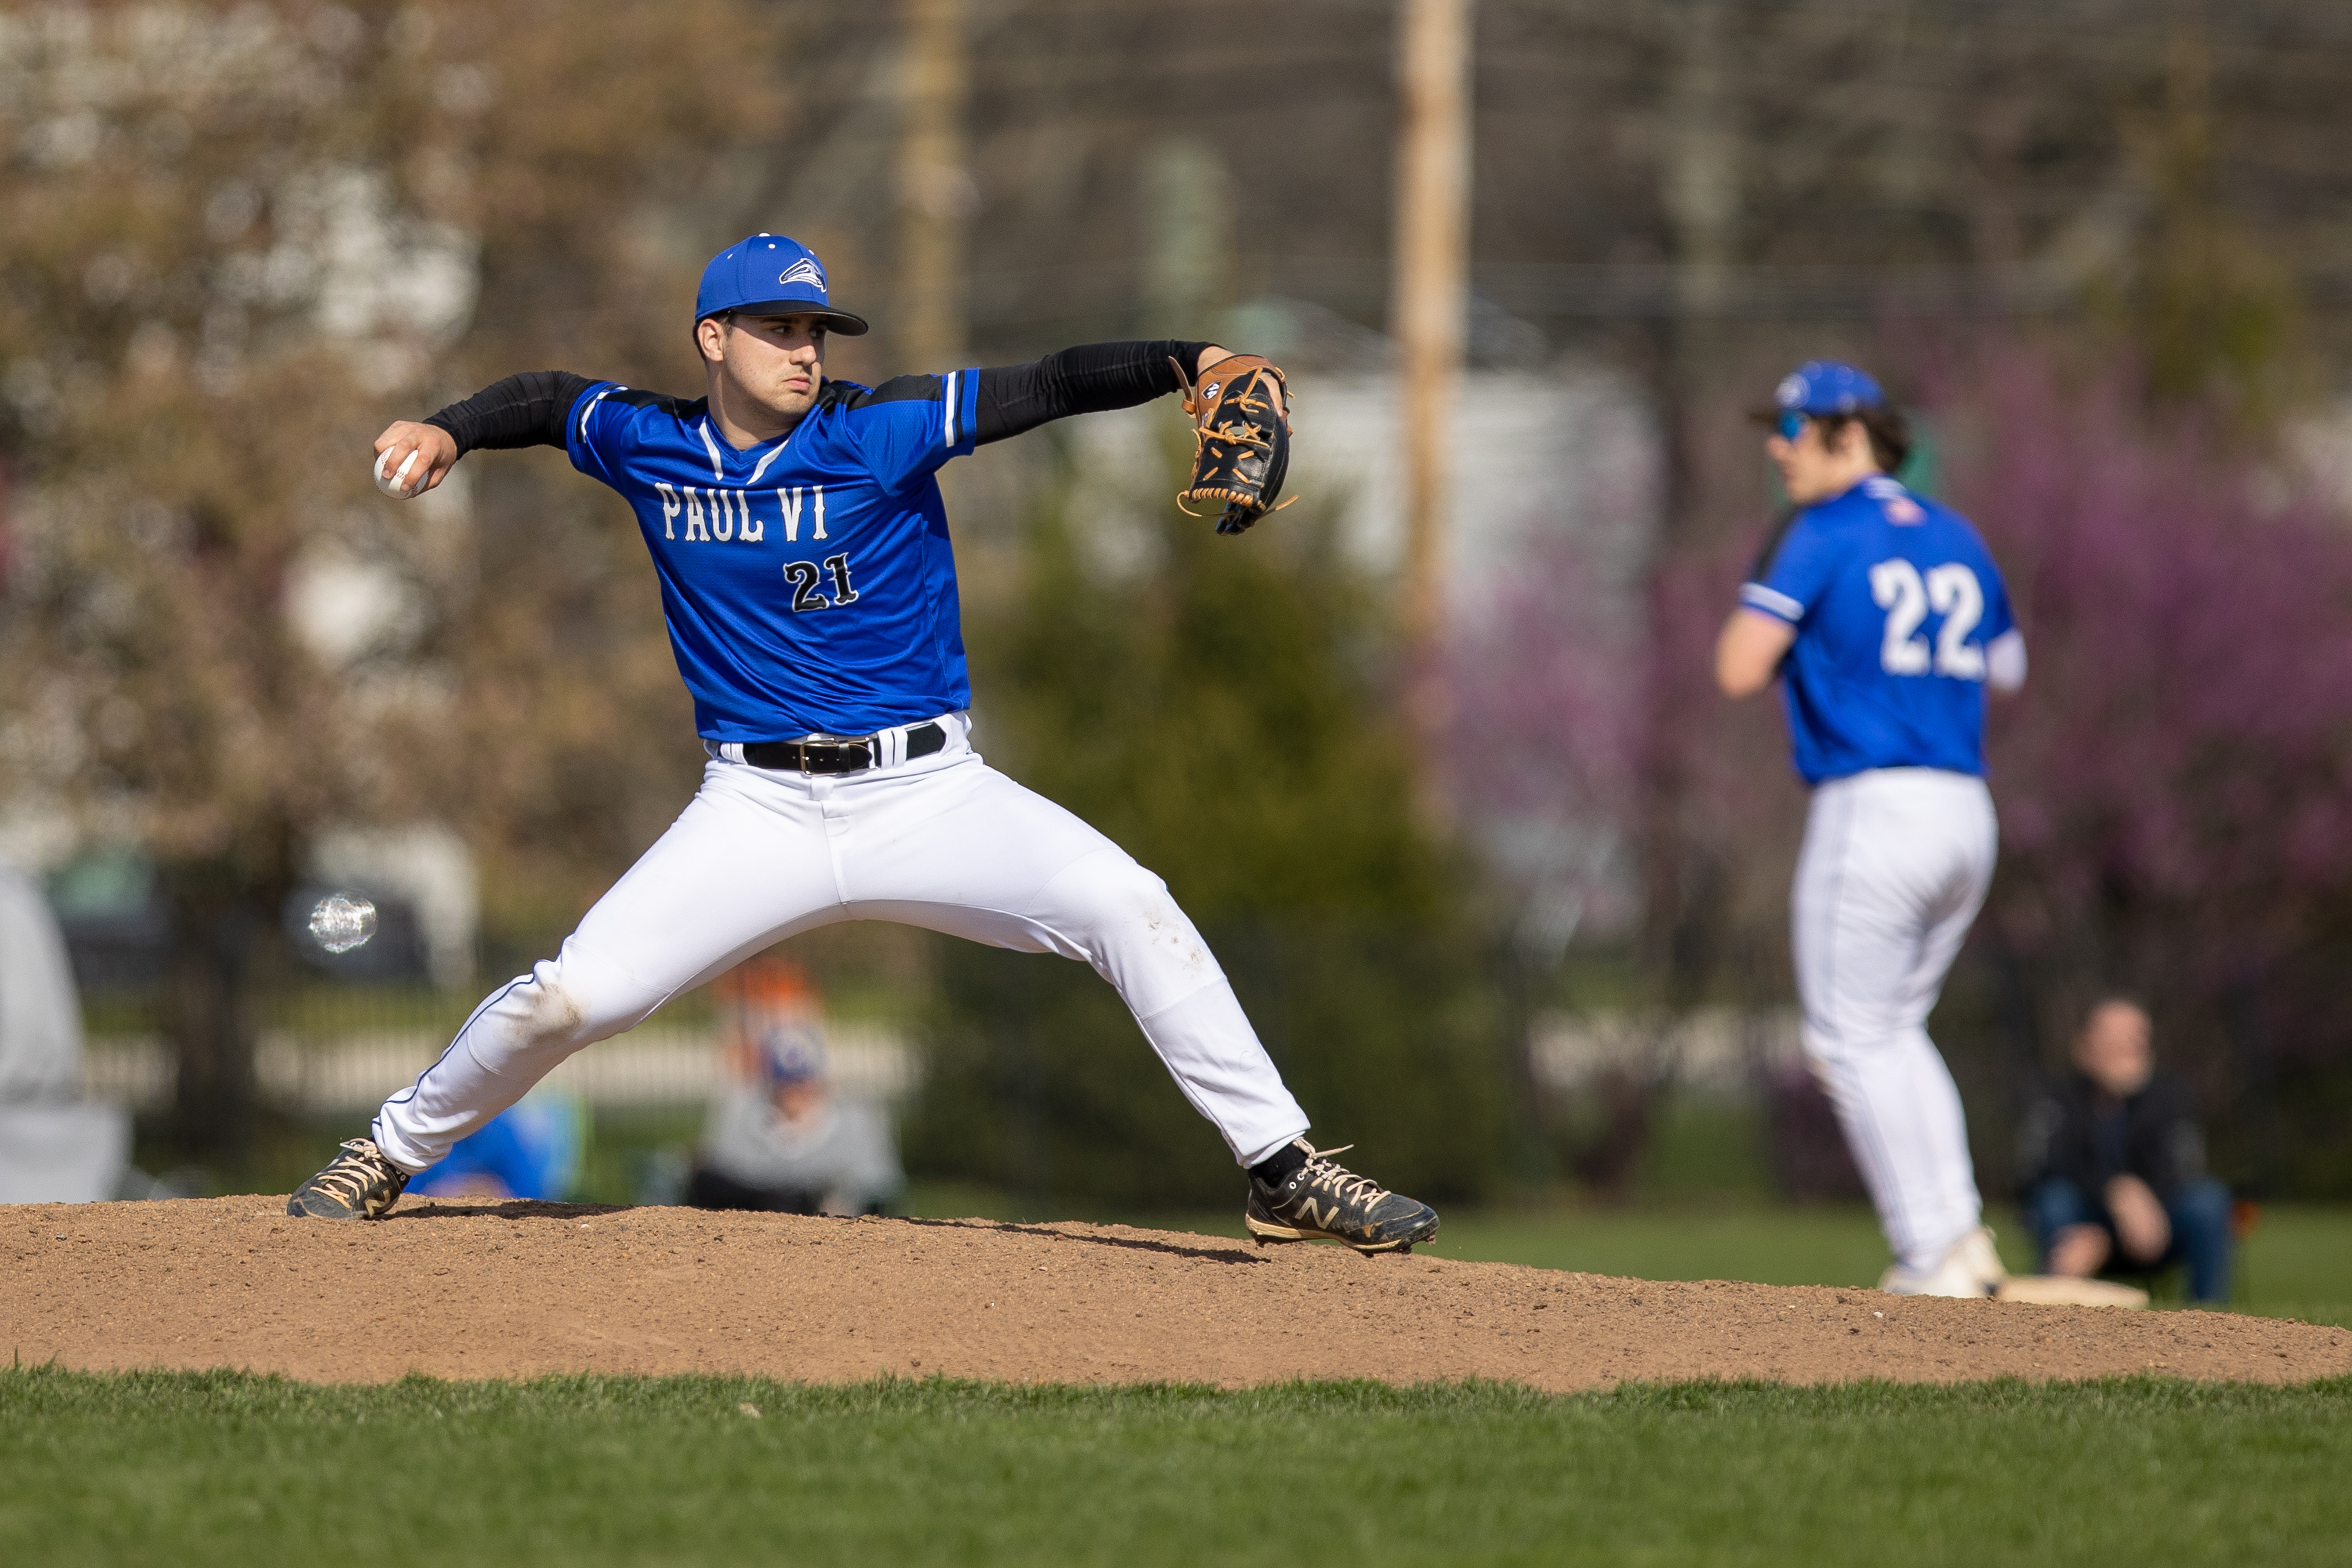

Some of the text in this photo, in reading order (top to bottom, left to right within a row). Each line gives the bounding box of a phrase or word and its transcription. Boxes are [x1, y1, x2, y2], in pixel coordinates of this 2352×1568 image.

[654, 482, 830, 542] PAUL VI
[783, 552, 860, 612] 21
[1868, 558, 1988, 681] 22
